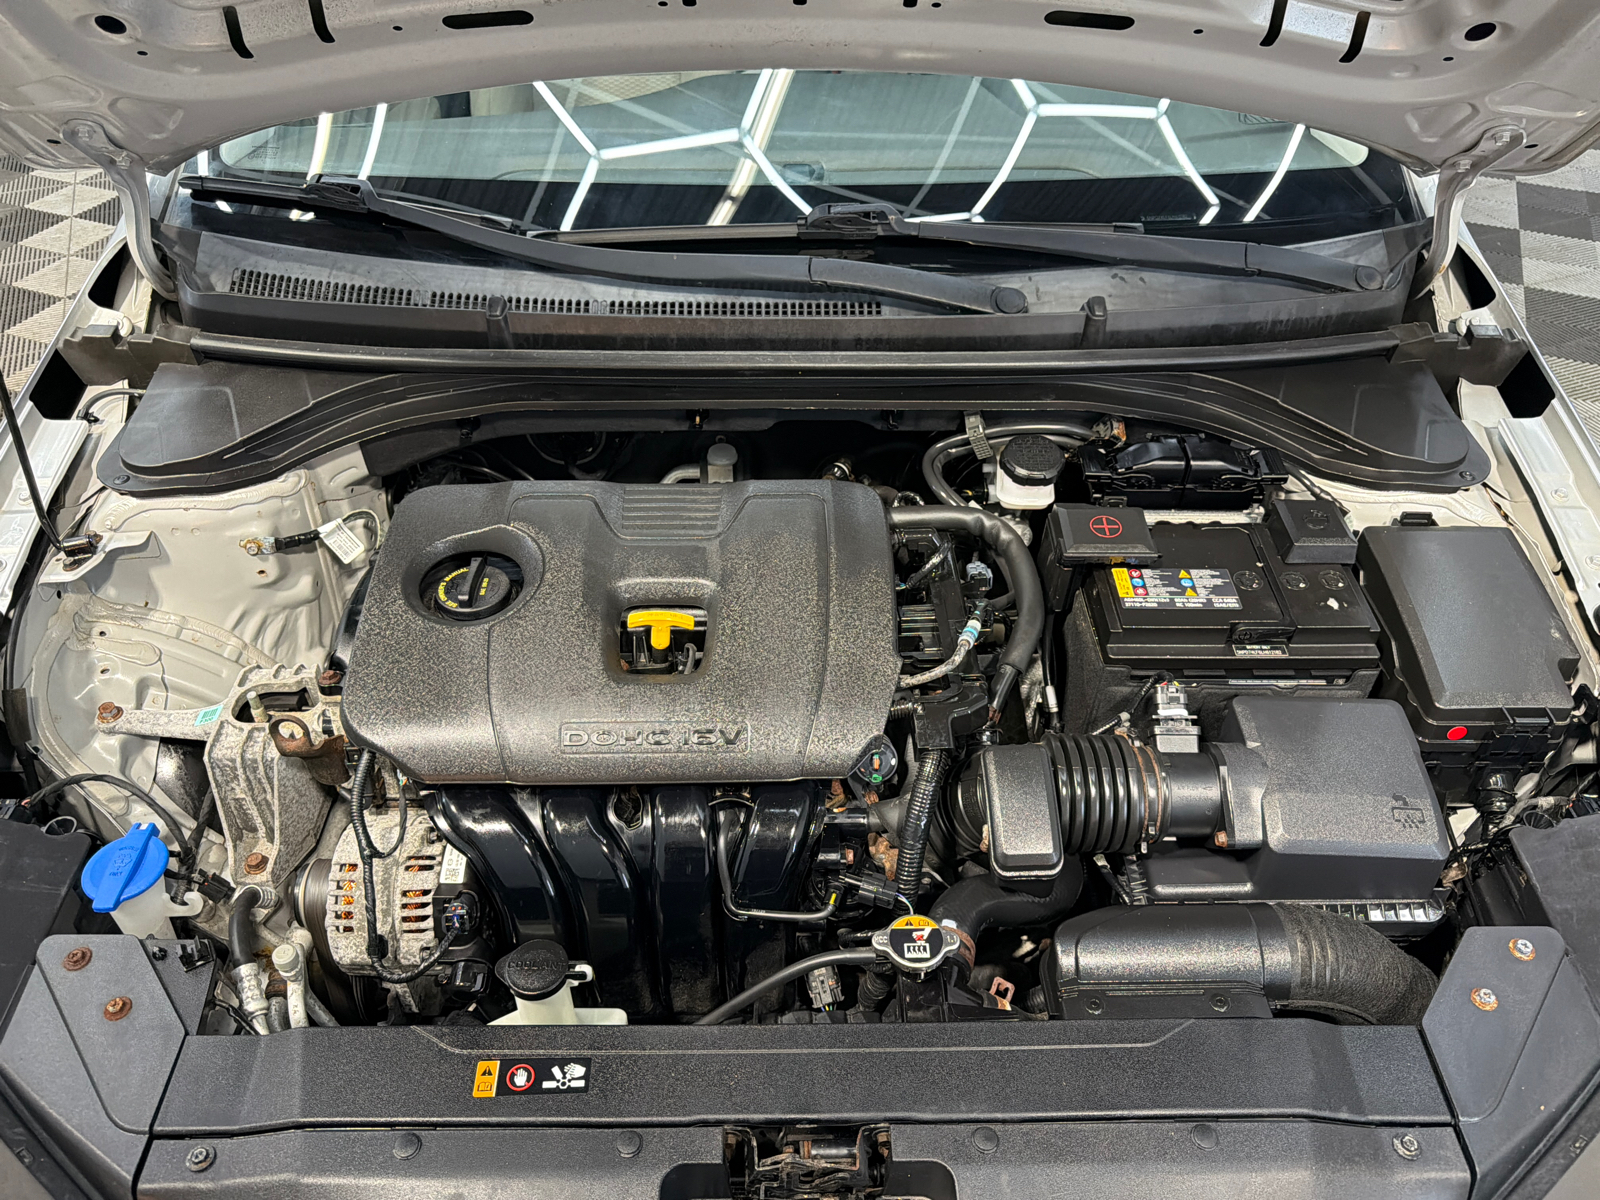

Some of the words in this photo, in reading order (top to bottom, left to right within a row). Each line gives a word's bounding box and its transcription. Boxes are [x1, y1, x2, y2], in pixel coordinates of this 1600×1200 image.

[444, 567, 469, 582] MANUAL
[563, 729, 671, 747] DOHC
[683, 727, 746, 746] 16V
[873, 935, 888, 944] HCC
[946, 935, 957, 943] 1.1
[507, 960, 567, 970] COOLANT
